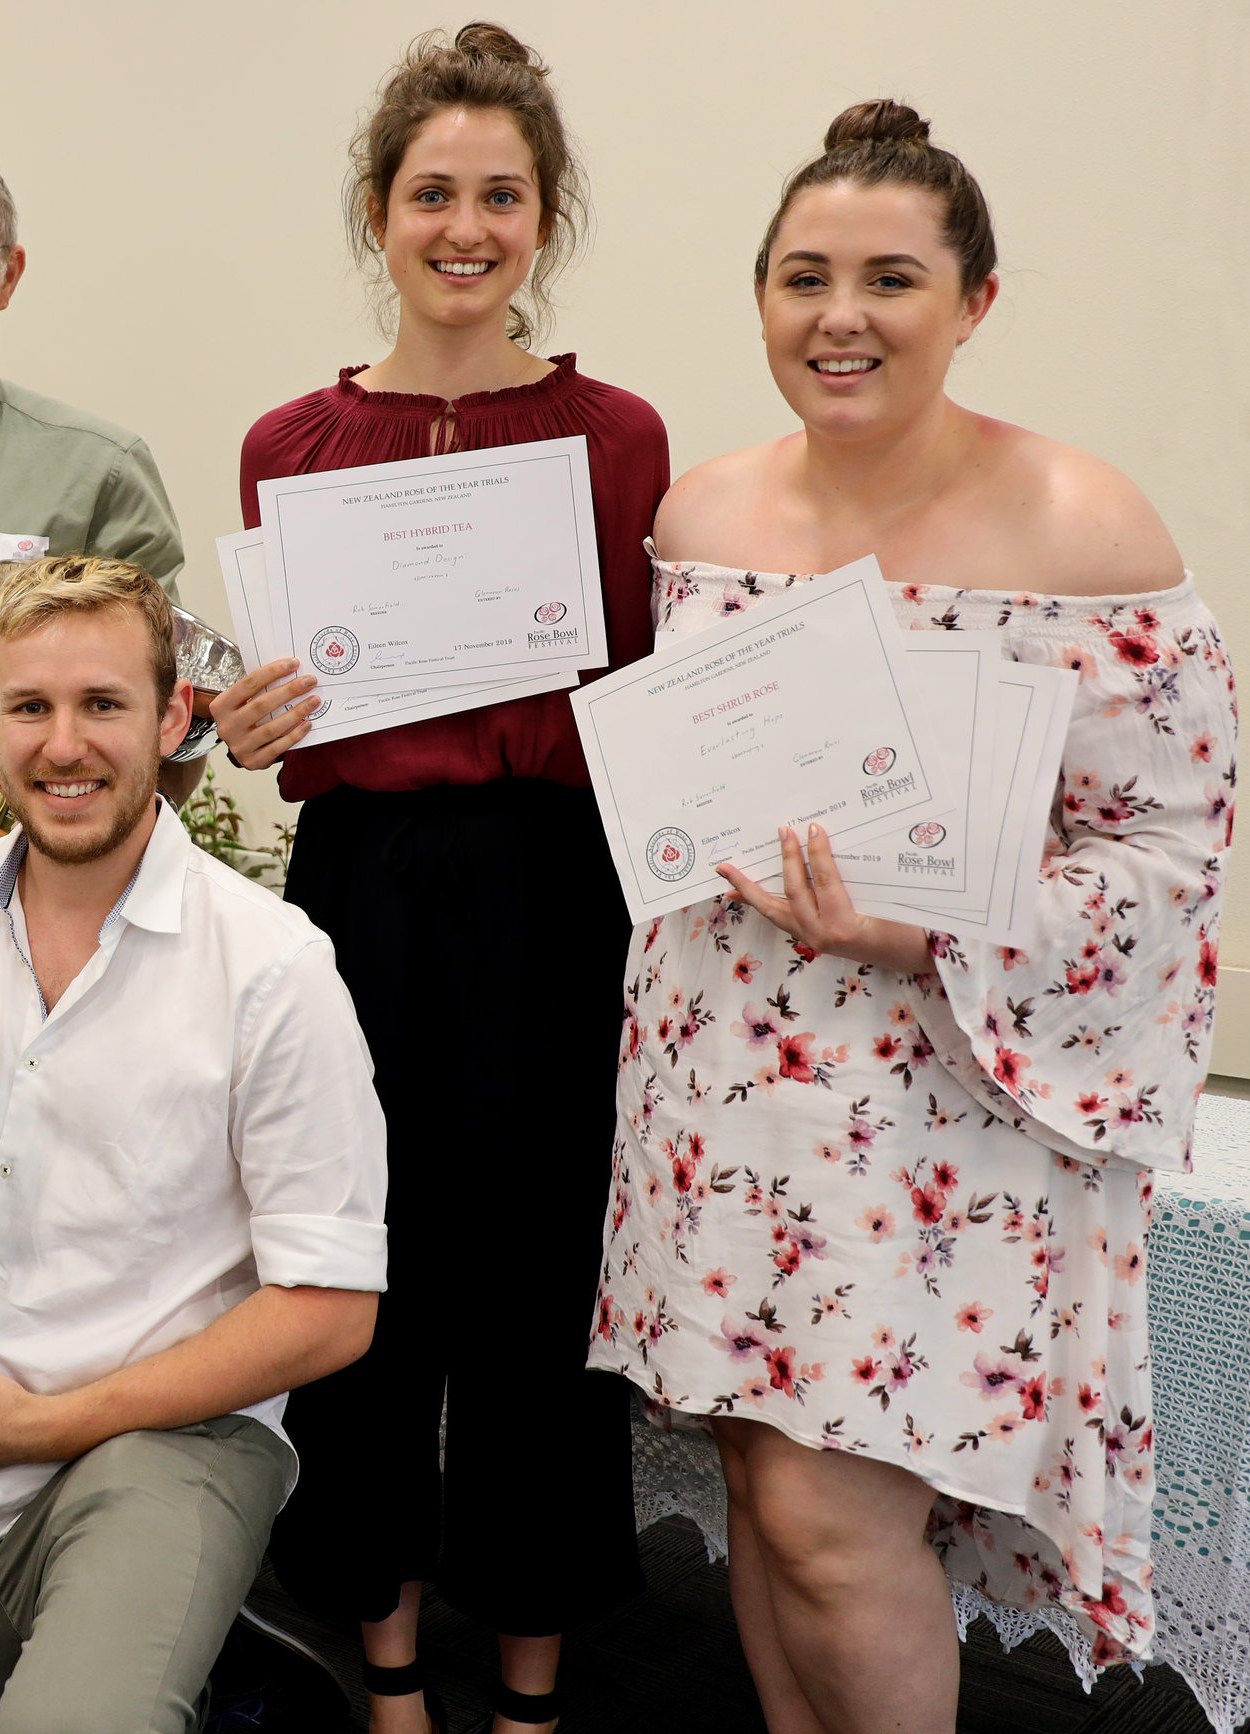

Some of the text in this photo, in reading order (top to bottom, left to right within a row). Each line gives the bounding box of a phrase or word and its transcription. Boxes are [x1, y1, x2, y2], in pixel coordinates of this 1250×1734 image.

[342, 476, 510, 506] NEW ZEALAND ROSE OF THE YEAR TRIALS
[381, 500, 408, 509] HAMILTON
[447, 492, 472, 501] ZEALAND
[383, 522, 473, 542] BEST HYBRID TEA
[392, 553, 464, 571] Diamond Design
[527, 627, 578, 642] Rose Bowl
[528, 638, 579, 649] FESTIVAL
[367, 639, 409, 650] Eileen Wilcox
[464, 641, 494, 650] November
[647, 621, 805, 696] NEW ZEALAND ROSE OF THE YEAR TRIALS
[684, 676, 711, 691] HAMILTON
[747, 650, 772, 664] ZEALAND
[692, 680, 780, 725] BEST SHRUB ROSE
[860, 771, 915, 800] Rose Bowl
[863, 783, 917, 808] FESTIVAL
[787, 800, 847, 827] 17 November 2019
[701, 826, 741, 846] Eileen Wilcox
[862, 854, 881, 862] 2019
[898, 853, 955, 869] Rose Bowl
[898, 865, 956, 876] FESTIVAL
